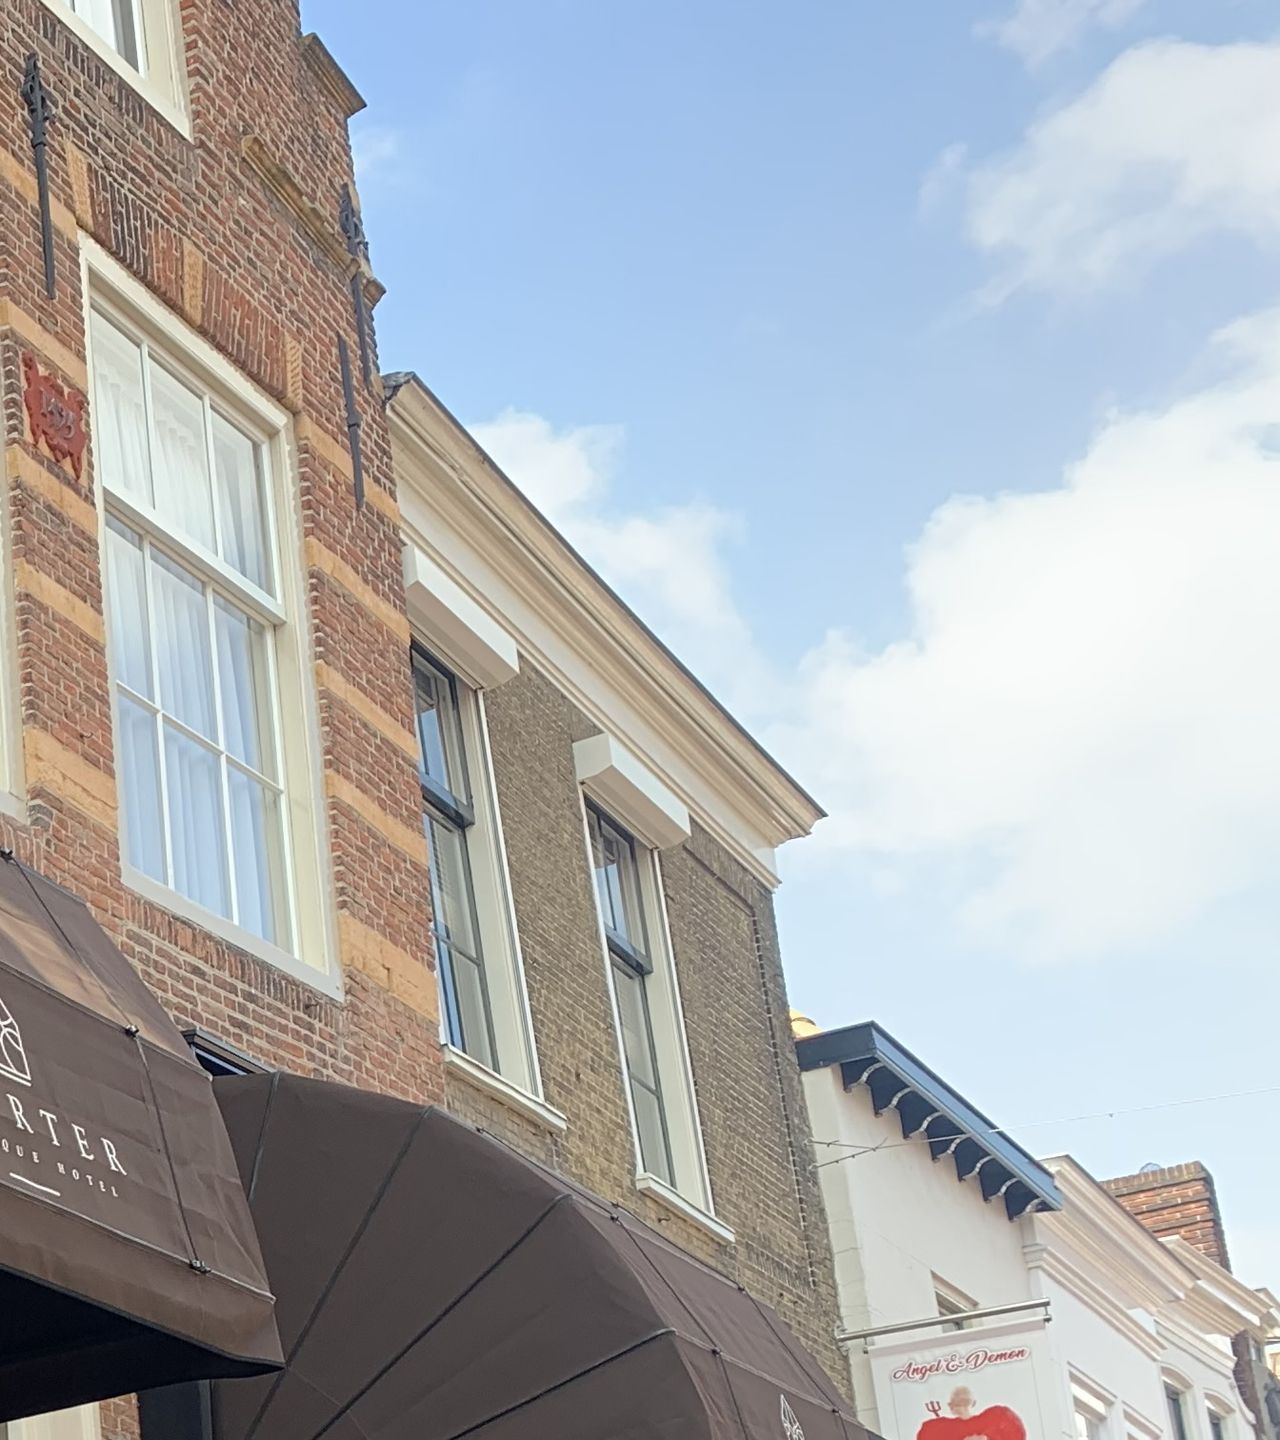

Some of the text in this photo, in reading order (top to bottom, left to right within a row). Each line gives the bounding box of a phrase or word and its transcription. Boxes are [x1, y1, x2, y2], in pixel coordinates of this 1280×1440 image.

[57, 1162, 119, 1198] HOTEL
[893, 1349, 1026, 1381] Angel & Demon
